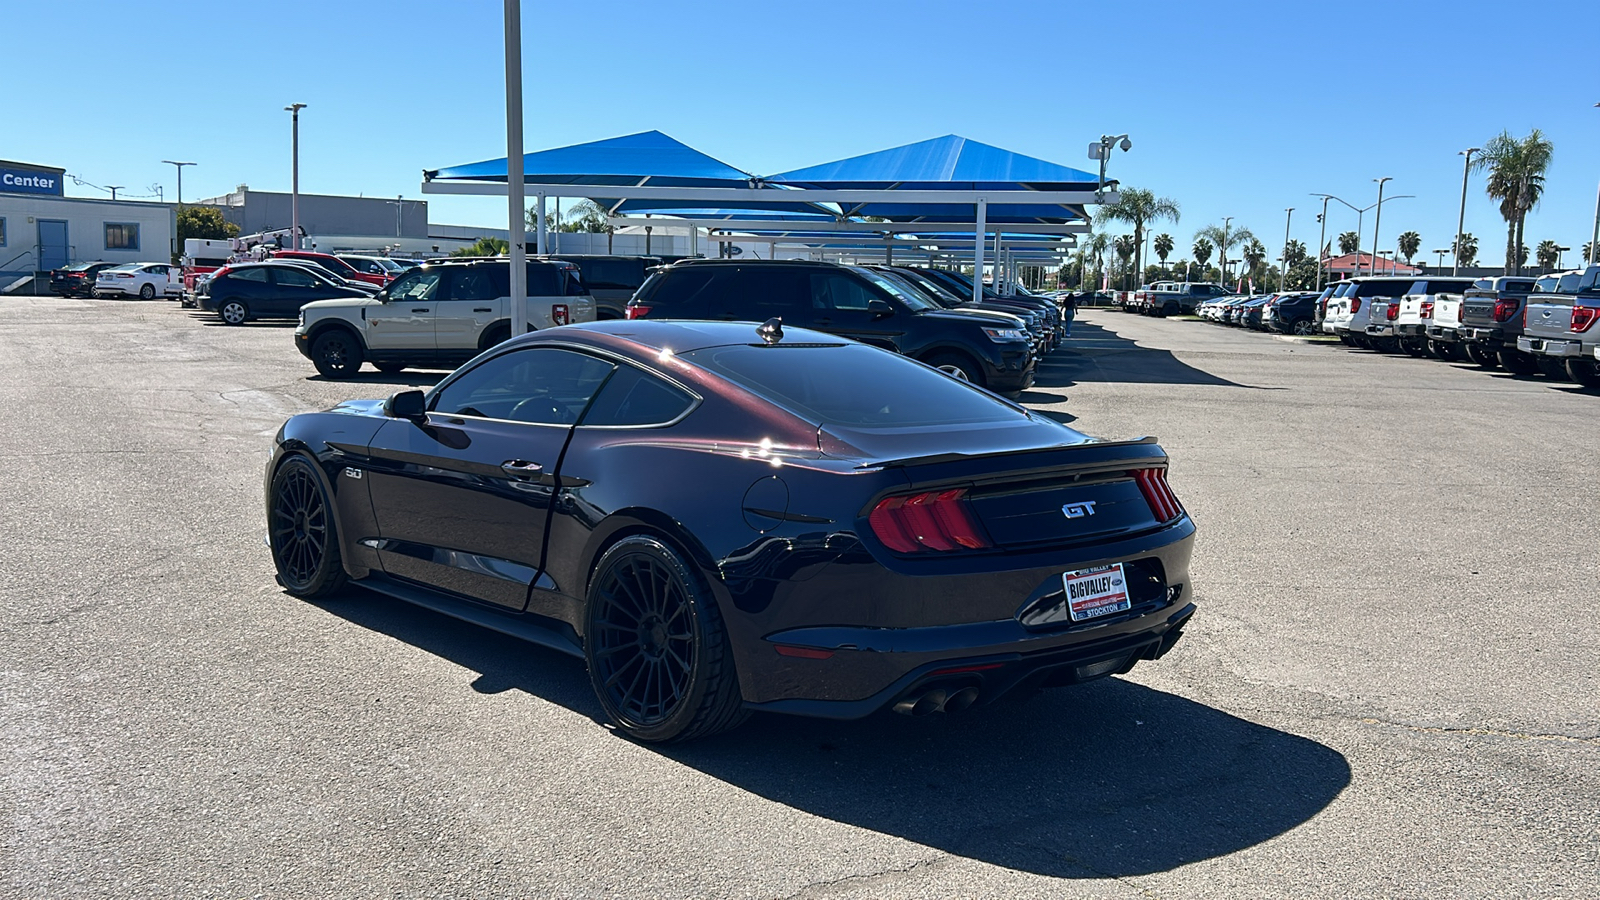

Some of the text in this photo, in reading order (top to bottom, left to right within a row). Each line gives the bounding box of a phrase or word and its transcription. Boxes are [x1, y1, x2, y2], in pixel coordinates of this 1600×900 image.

[3, 173, 55, 189] Center
[1061, 500, 1097, 519] GT
[1090, 565, 1109, 573] VALLEY
[1069, 576, 1111, 599] BIGVALLEY
[1086, 603, 1118, 617] STOCKTON
